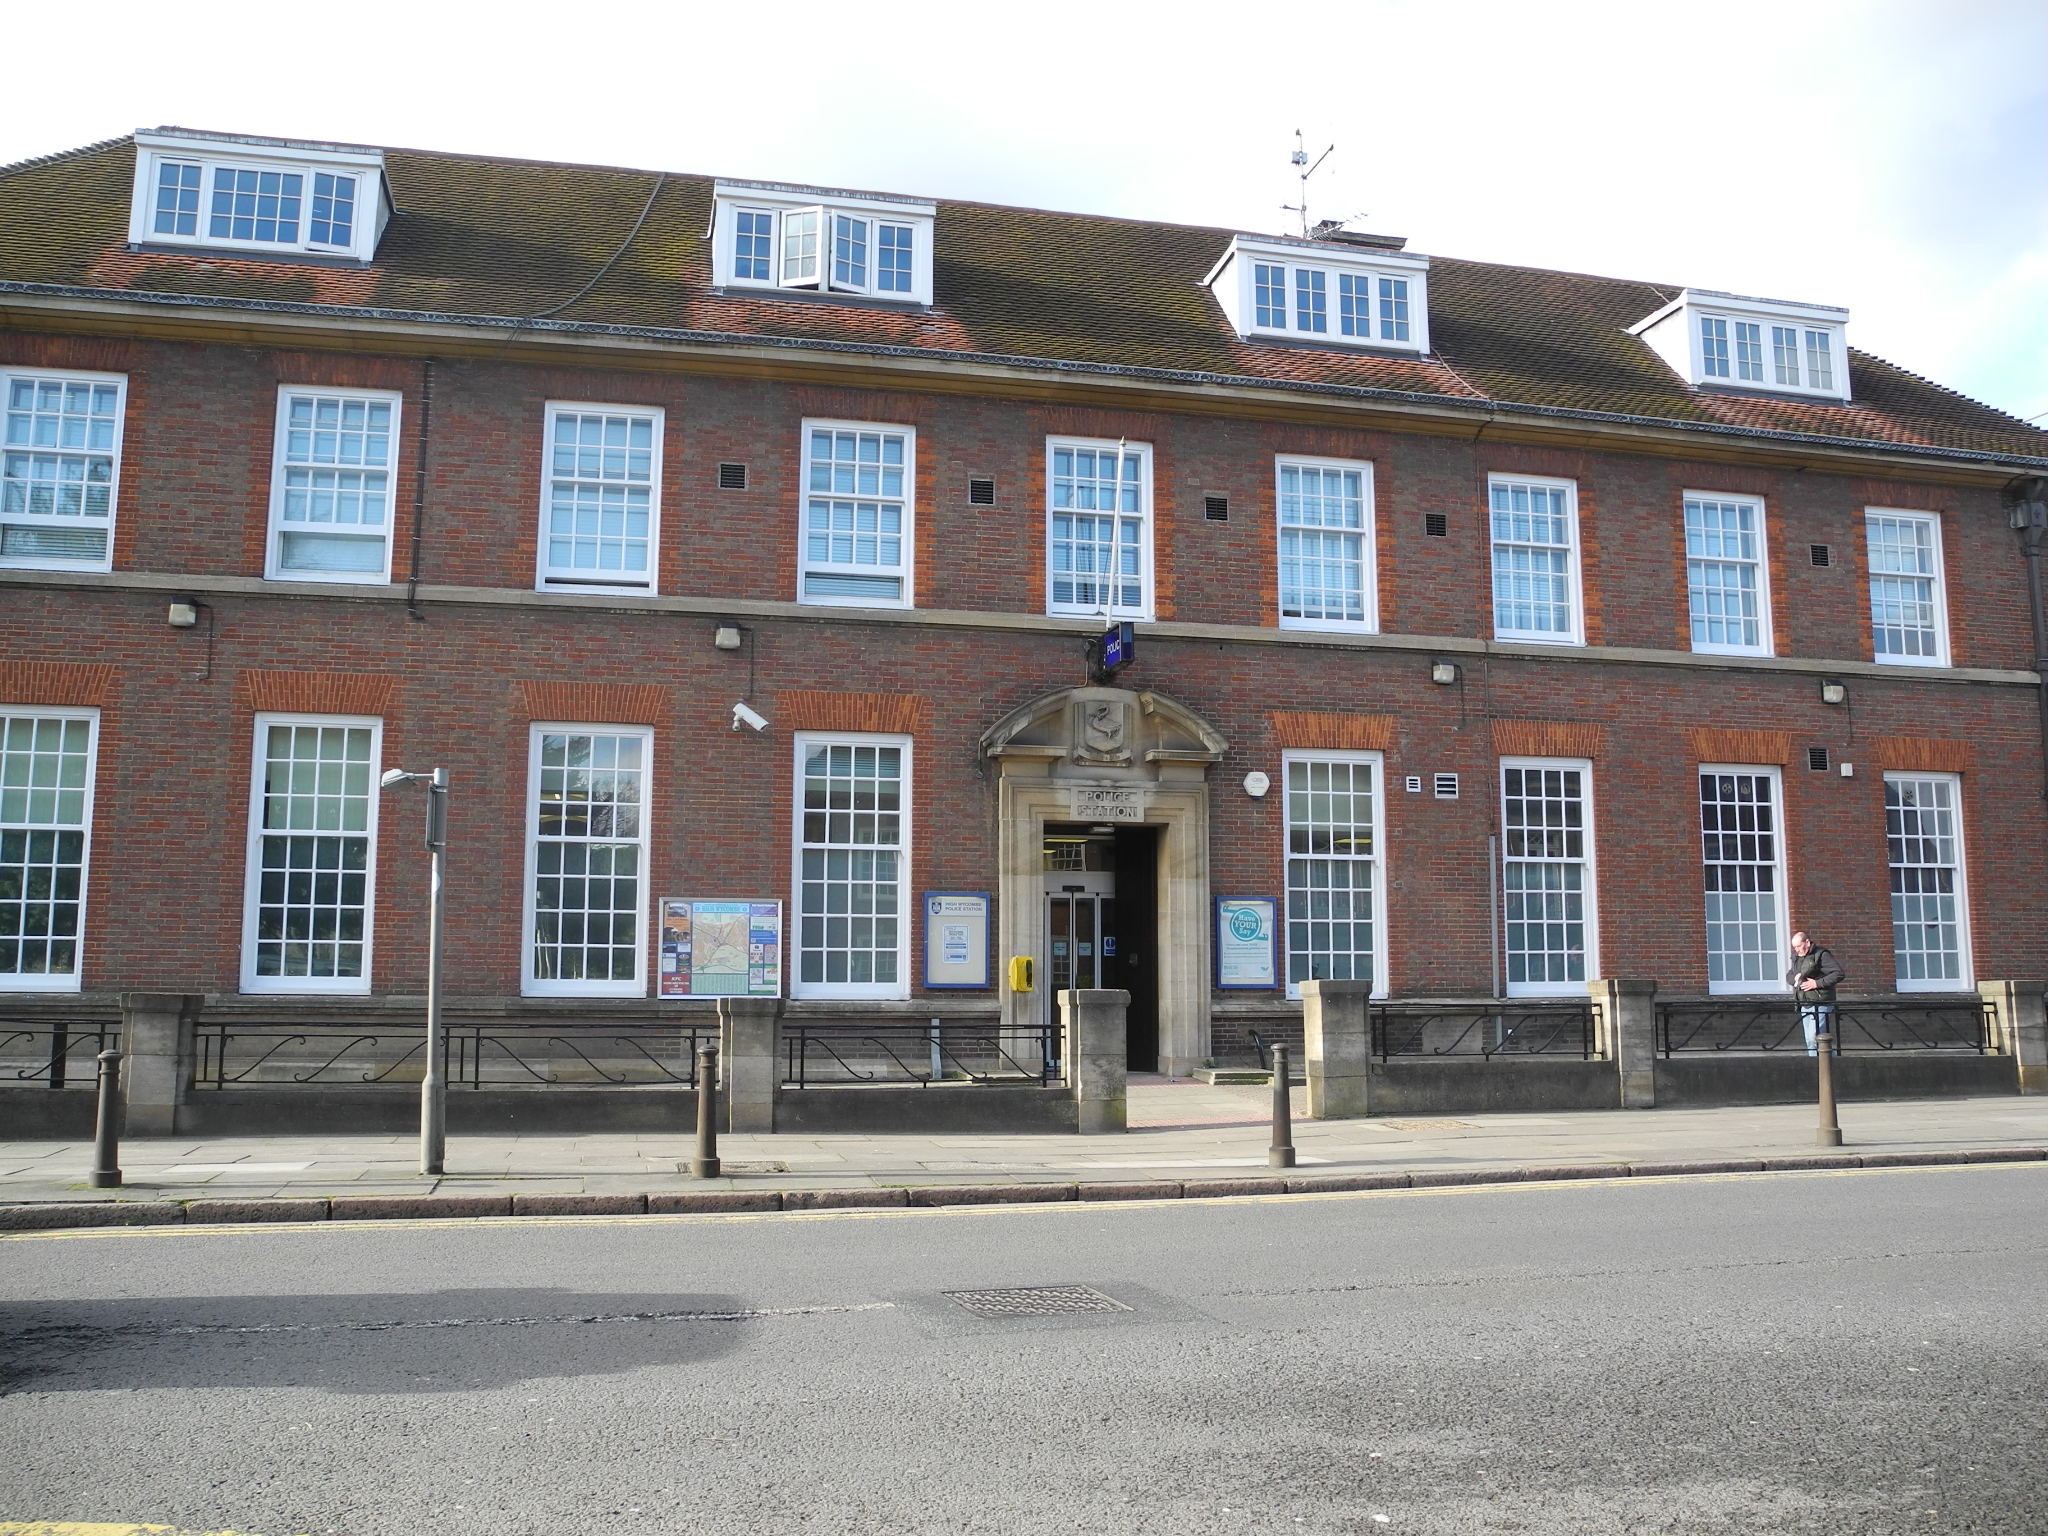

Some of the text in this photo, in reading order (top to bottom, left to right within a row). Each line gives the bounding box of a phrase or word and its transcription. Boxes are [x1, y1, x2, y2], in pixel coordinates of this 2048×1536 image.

[1106, 639, 1120, 656] POLIC
[1085, 791, 1129, 802] POLICE
[1078, 805, 1137, 818] STATION
[1234, 920, 1257, 929] YOUR
[1239, 927, 1252, 936] Say
